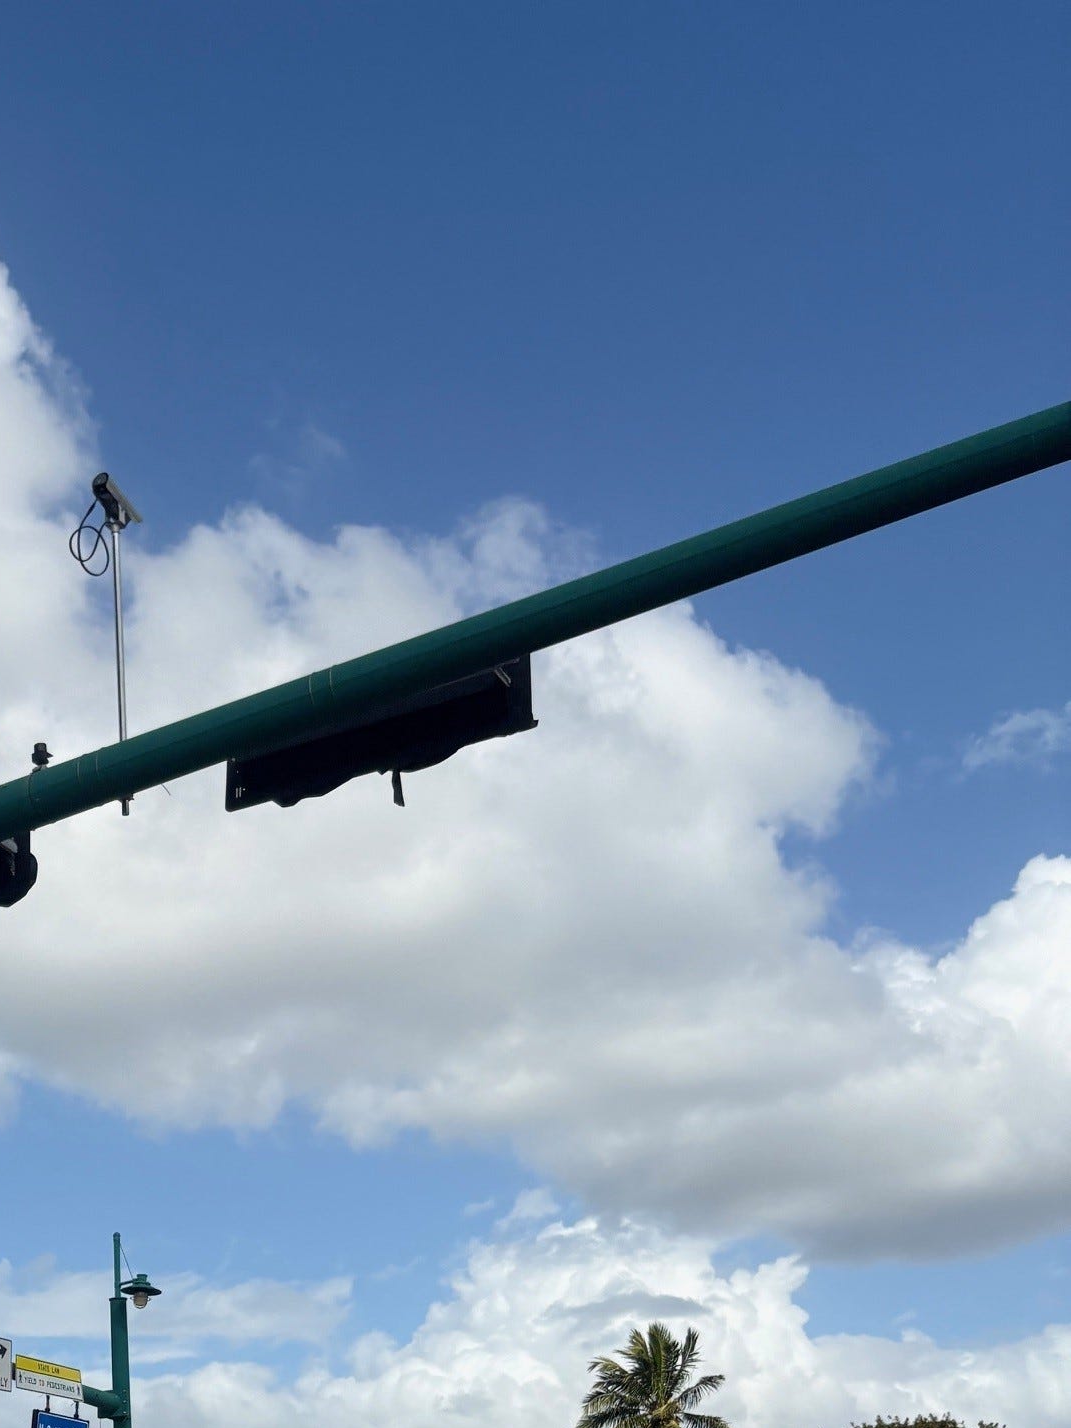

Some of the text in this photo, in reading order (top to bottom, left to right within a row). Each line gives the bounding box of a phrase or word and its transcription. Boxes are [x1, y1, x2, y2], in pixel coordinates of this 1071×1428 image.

[38, 1363, 60, 1374] STATE LAW
[24, 1377, 75, 1393] YIELD TO PEDESTRIANS
